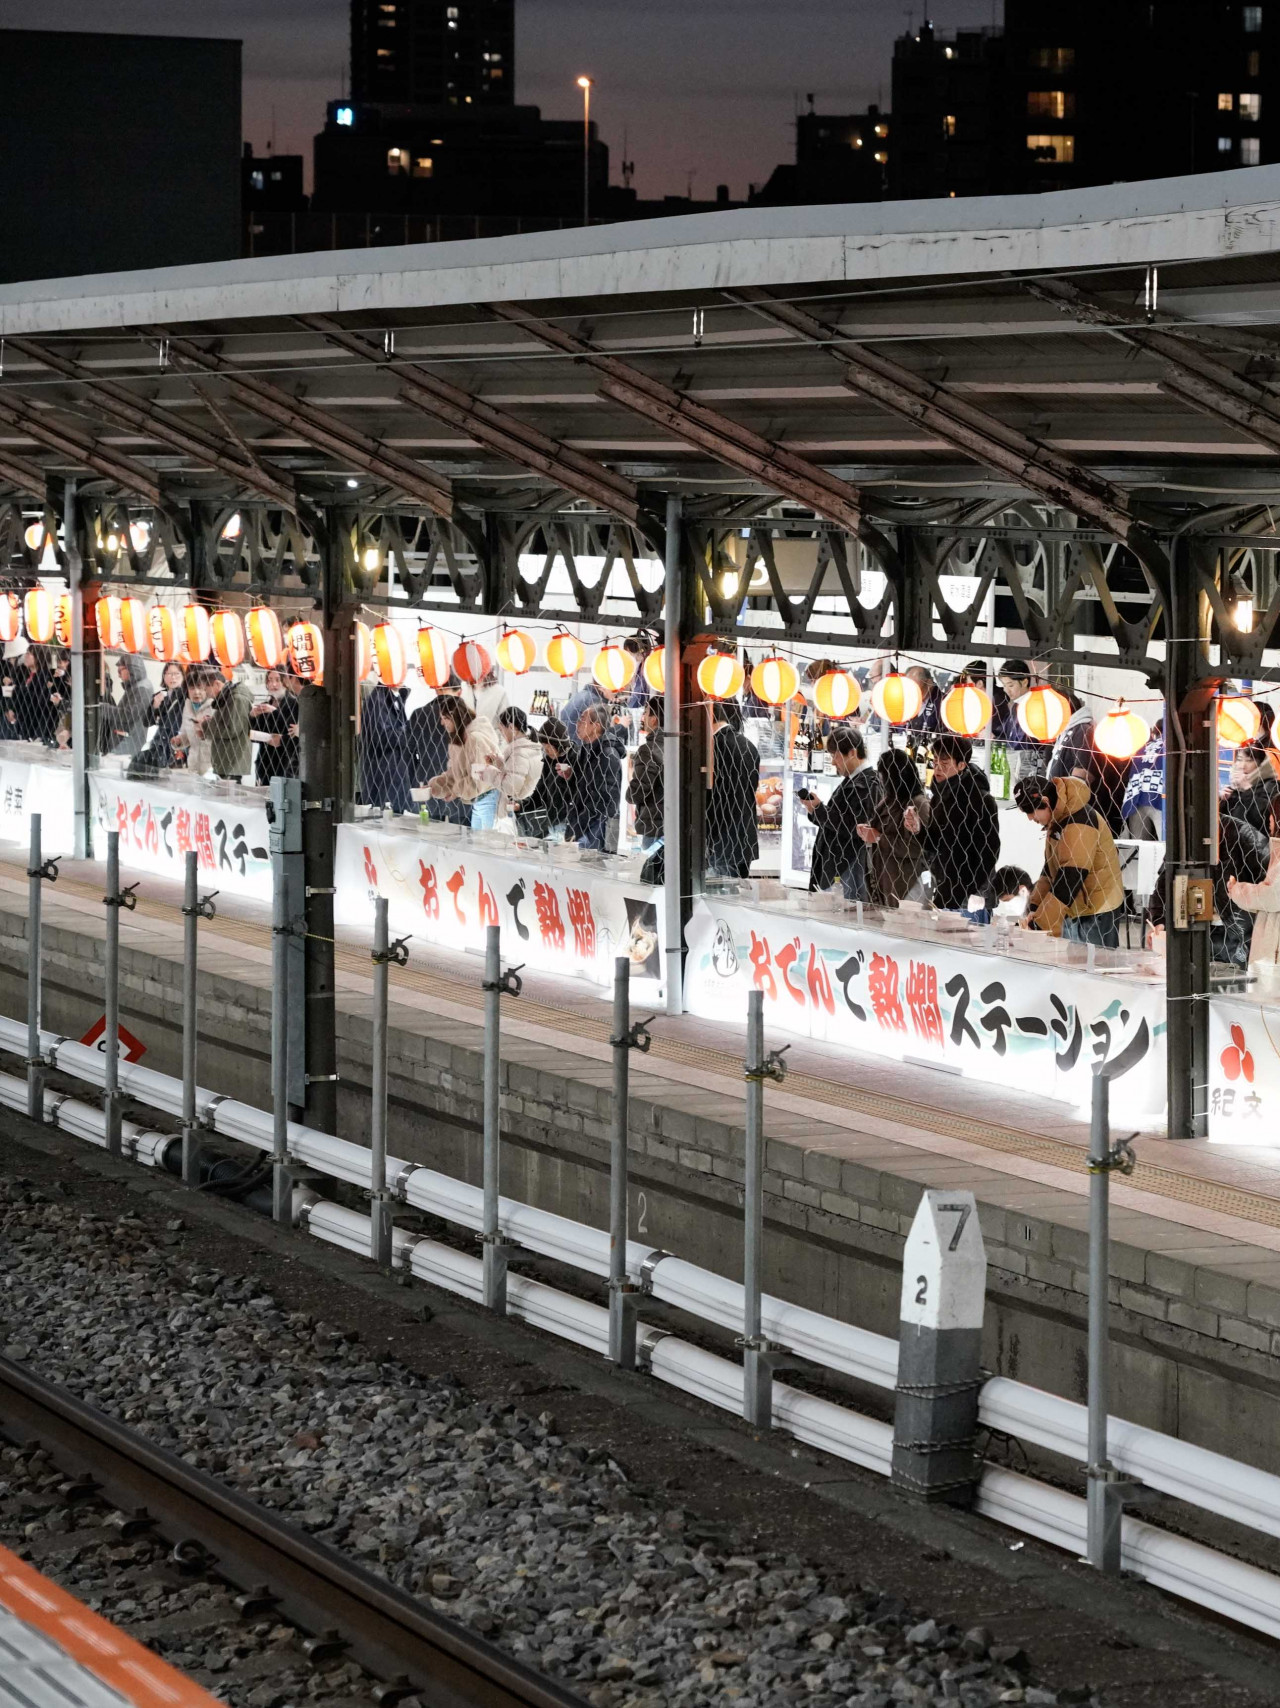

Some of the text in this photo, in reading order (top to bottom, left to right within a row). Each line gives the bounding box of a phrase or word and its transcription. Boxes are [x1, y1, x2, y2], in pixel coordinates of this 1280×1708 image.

[748, 930, 1150, 1083] おでんで熱燗ステーション
[1210, 1087, 1264, 1119] 紀文
[937, 1203, 972, 1252] 7
[914, 1274, 929, 1306] 2
